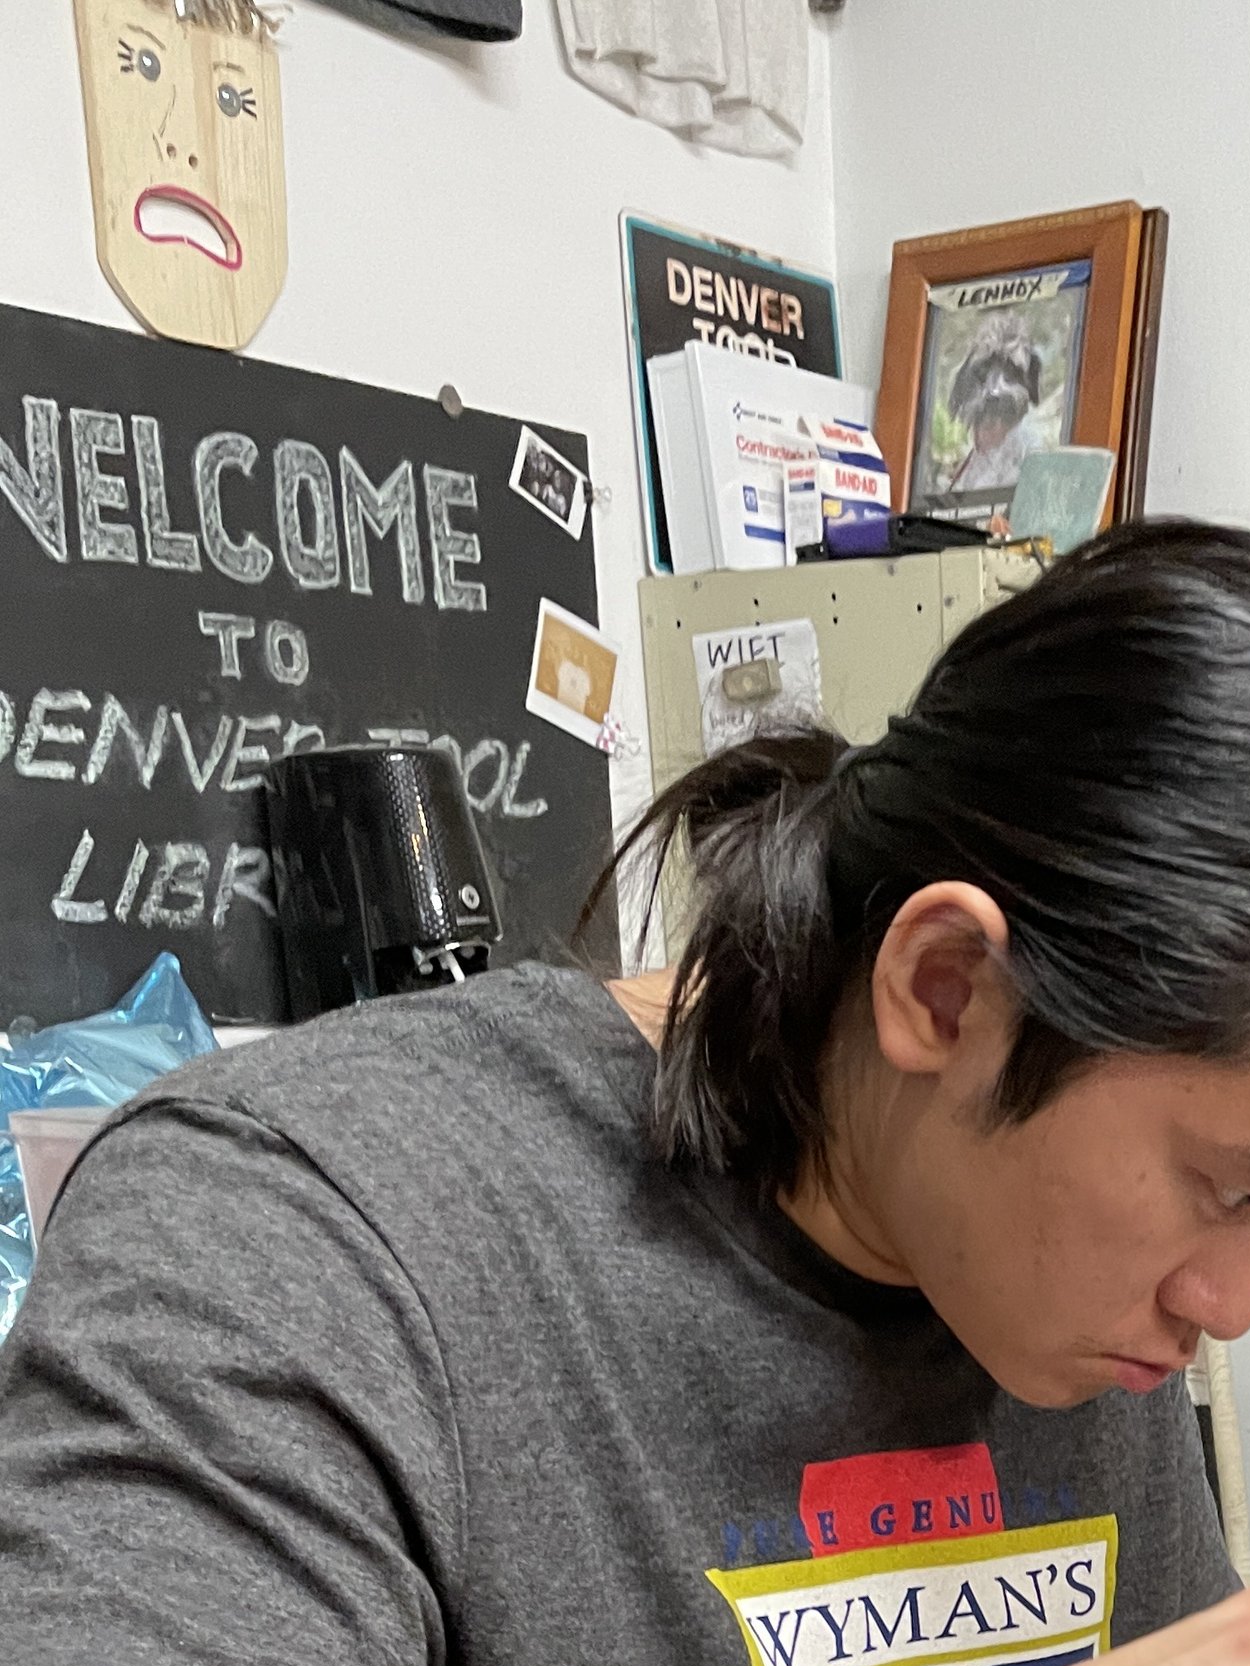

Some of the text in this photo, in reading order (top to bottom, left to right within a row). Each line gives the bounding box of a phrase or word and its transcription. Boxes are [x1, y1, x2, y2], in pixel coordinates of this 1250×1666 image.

[667, 257, 805, 340] DENVER
[835, 466, 878, 497] BAND-AID
[199, 610, 310, 686] TO
[0, 685, 548, 818] ENVE OL
[51, 829, 276, 929] LIBR
